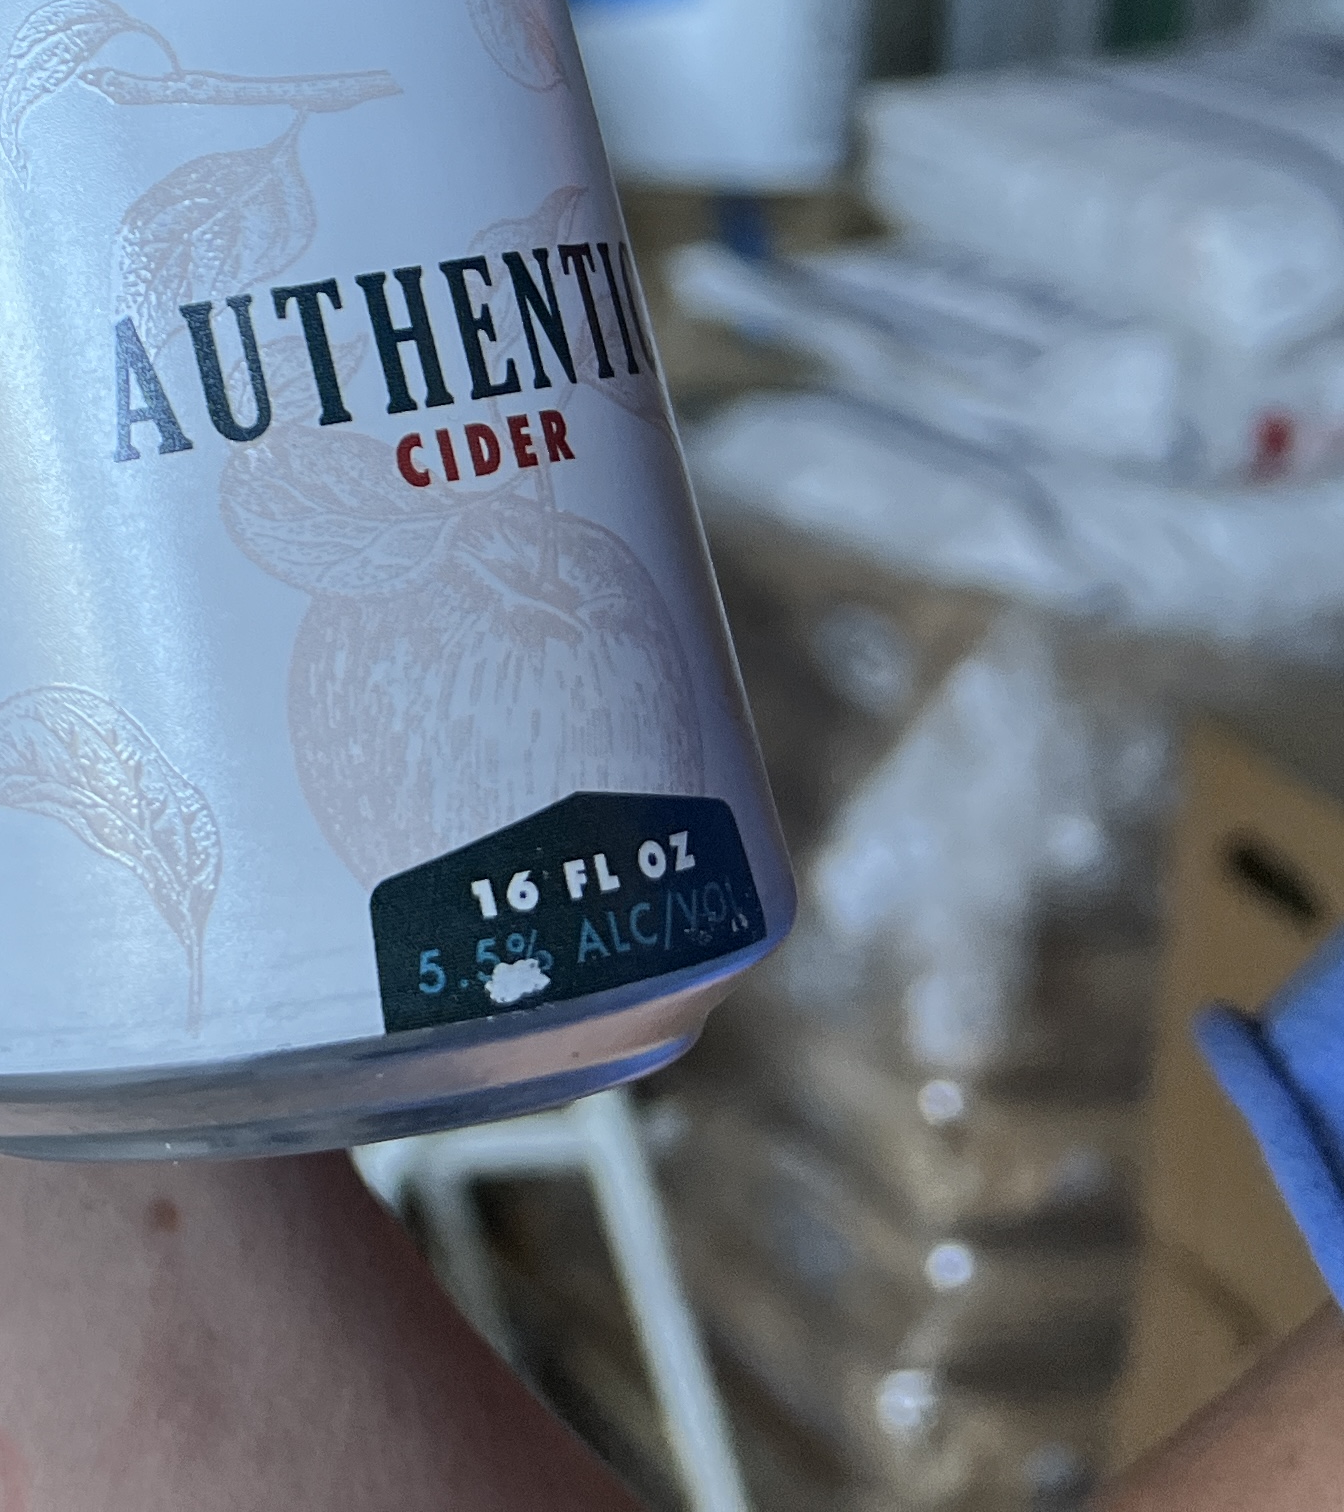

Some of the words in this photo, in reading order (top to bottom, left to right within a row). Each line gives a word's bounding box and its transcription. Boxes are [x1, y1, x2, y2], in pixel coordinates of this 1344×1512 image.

[395, 409, 577, 488] CIDER
[470, 870, 541, 920] 16
[563, 852, 621, 901] FL
[637, 830, 696, 879] OZ
